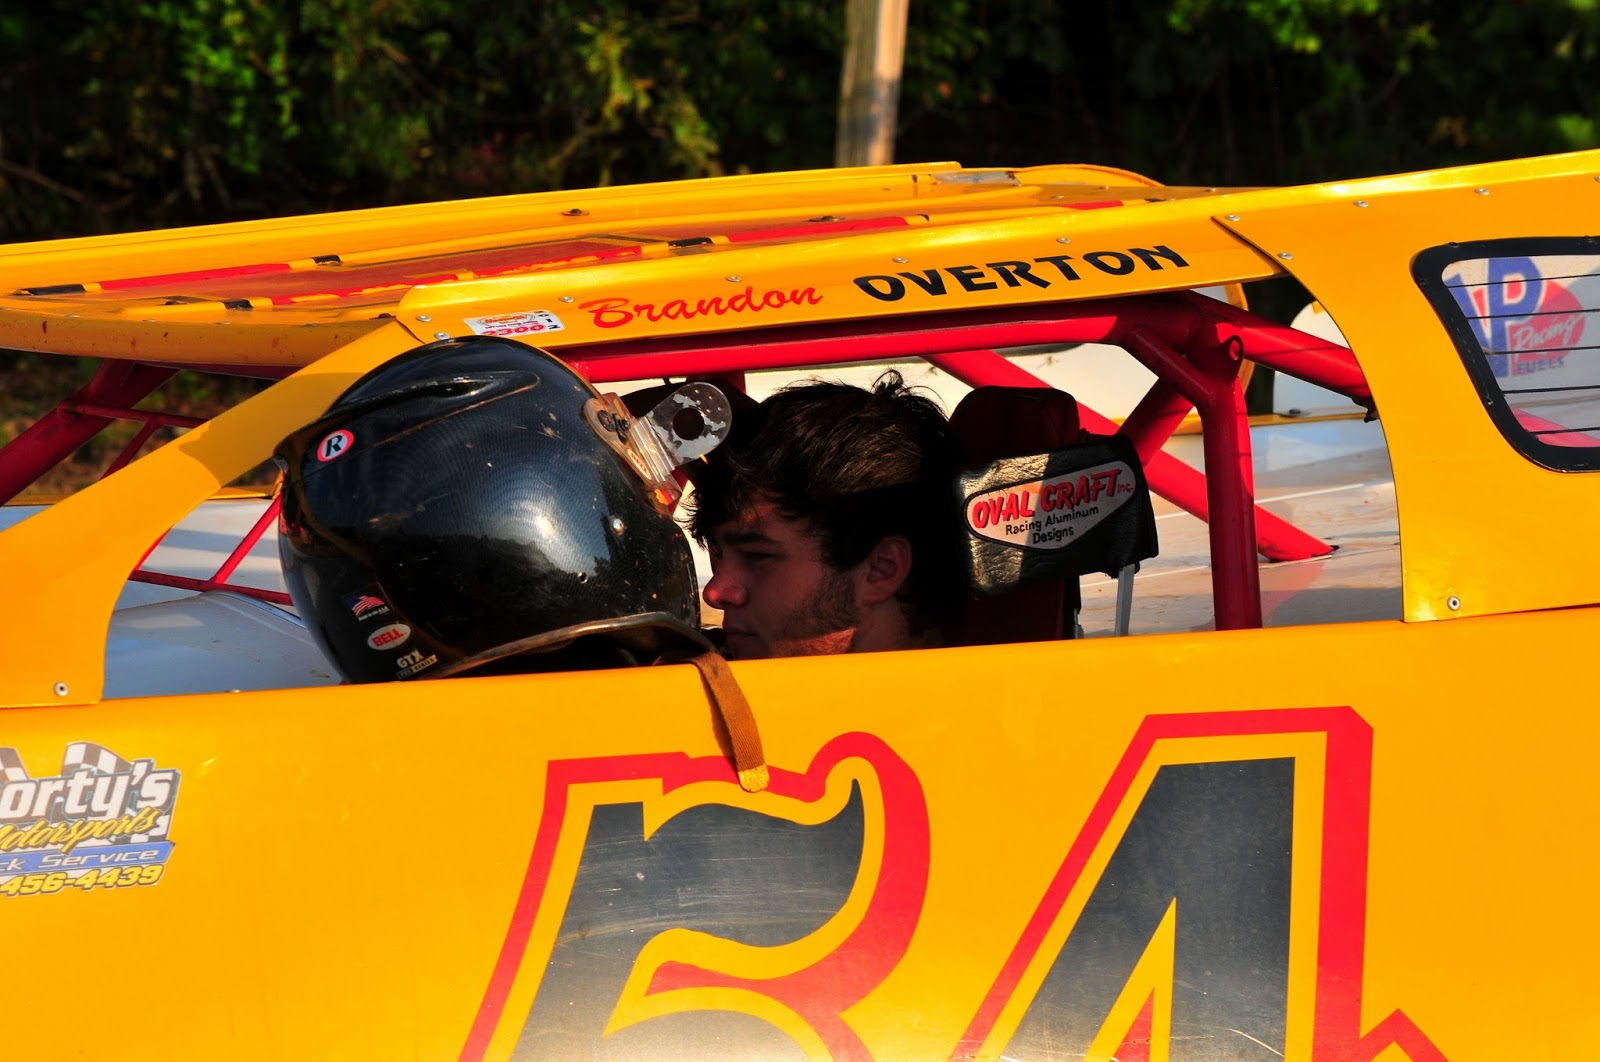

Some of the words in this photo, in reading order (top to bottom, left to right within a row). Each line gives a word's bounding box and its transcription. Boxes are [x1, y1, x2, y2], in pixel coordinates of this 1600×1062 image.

[578, 286, 823, 329] Brandon
[853, 245, 1190, 302] OVERTON
[1514, 313, 1583, 362] Racing
[1518, 356, 1565, 375] FUELS
[972, 490, 1035, 529] OVAL
[1040, 468, 1122, 513] CRAFT
[1005, 520, 1042, 536] Racing
[1045, 506, 1099, 527] Aluminum
[1032, 525, 1075, 545] Designs
[371, 627, 404, 648] BELL
[396, 649, 424, 669] GTX
[38, 849, 158, 869] Service
